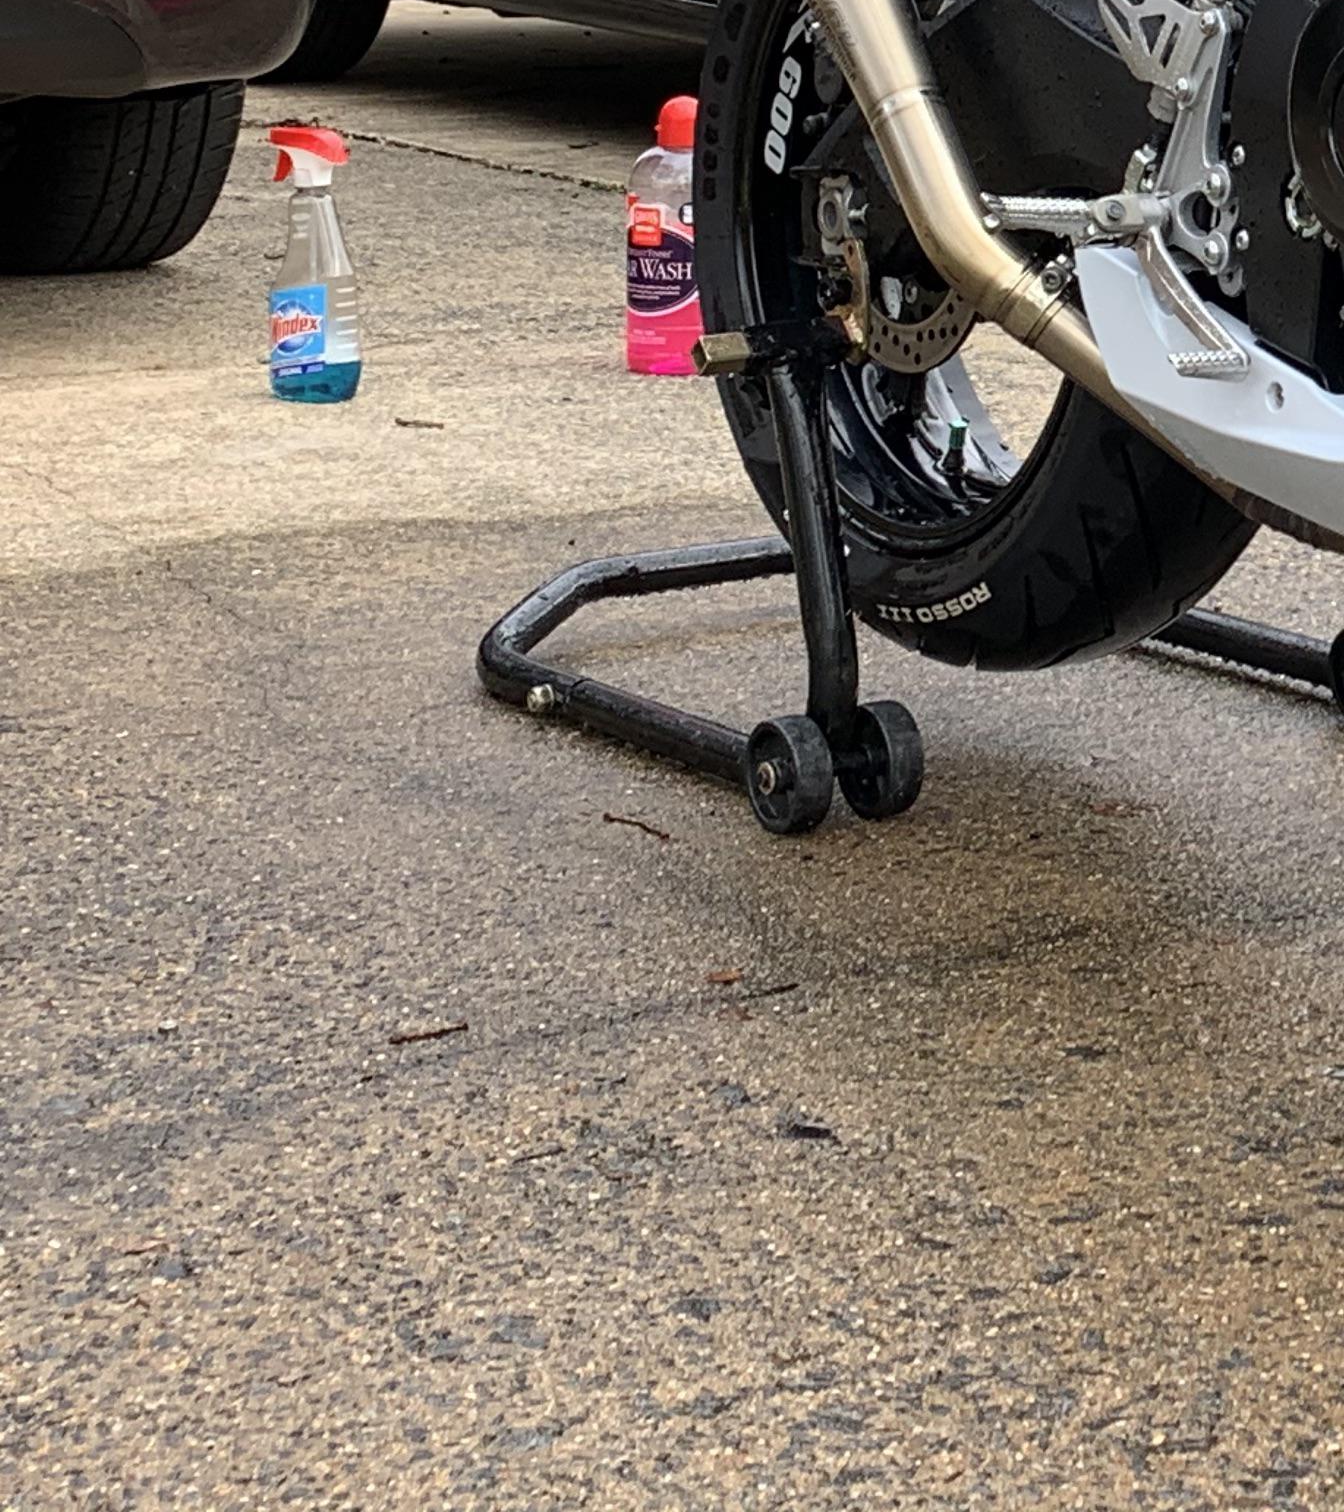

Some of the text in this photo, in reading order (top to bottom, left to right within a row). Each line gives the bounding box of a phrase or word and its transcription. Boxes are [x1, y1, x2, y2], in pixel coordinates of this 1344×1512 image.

[763, 55, 802, 175] 600
[639, 258, 693, 280] WASH
[876, 581, 993, 624] ROSSO III
